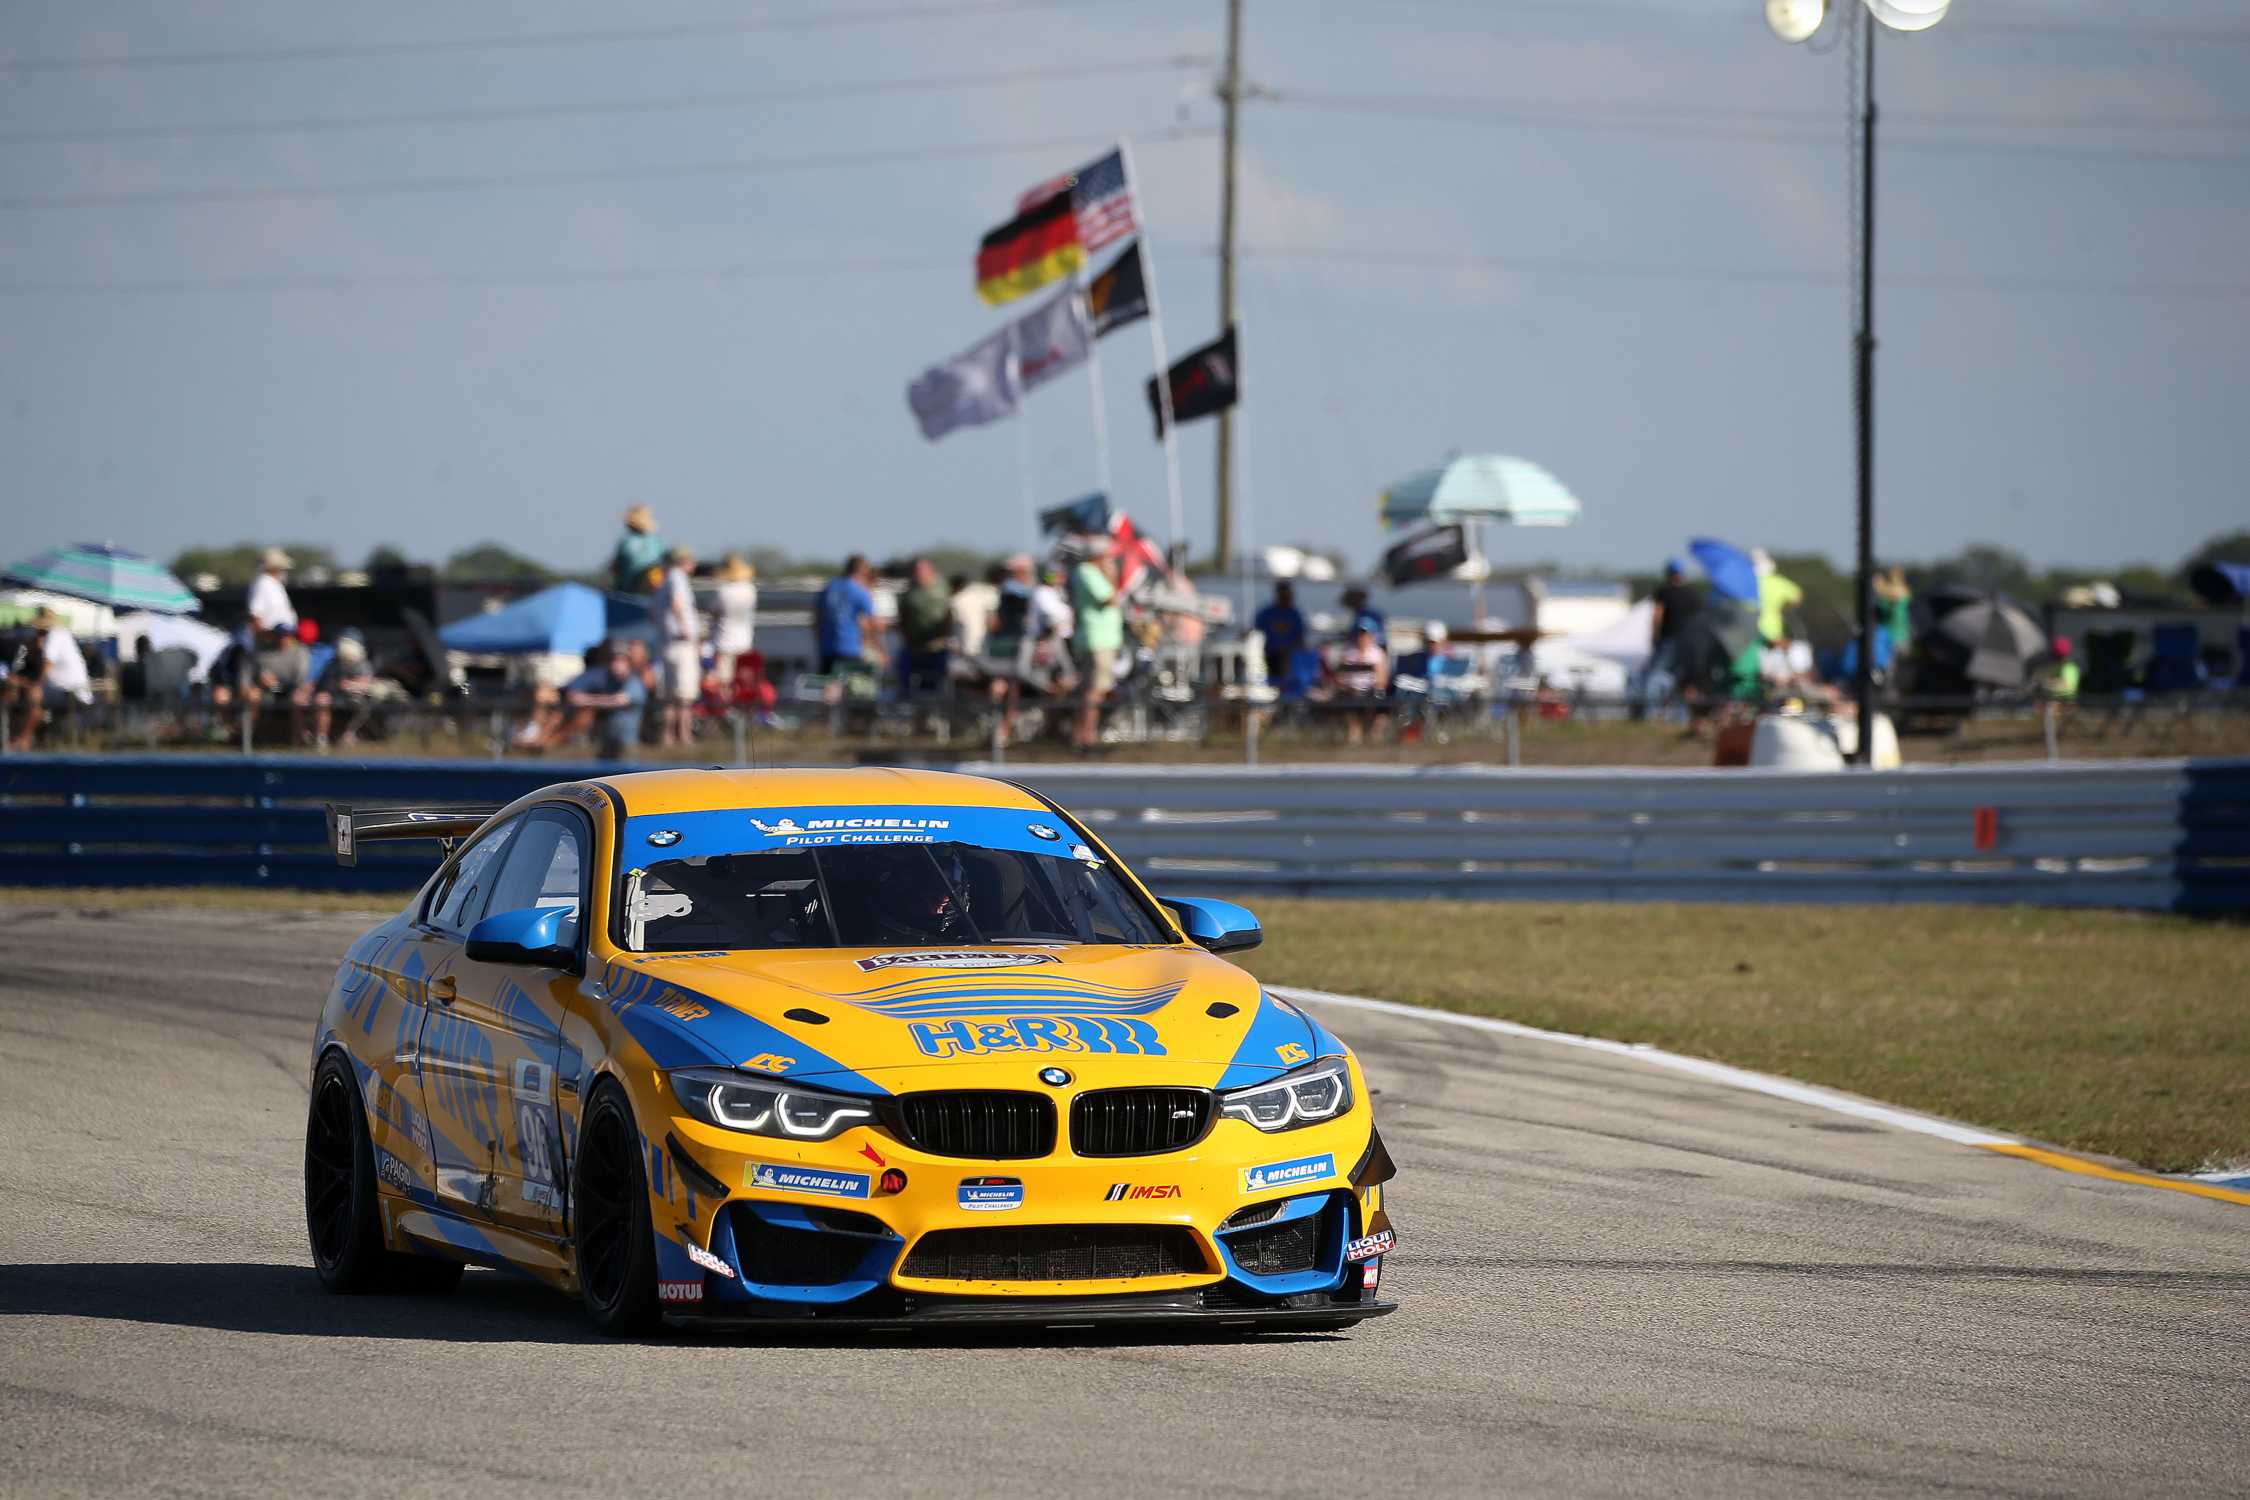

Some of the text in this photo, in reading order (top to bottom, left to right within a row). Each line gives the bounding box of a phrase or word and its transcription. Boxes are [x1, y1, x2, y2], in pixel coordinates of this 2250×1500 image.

[808, 818, 950, 829] MICHELIN
[786, 834, 934, 846] PILOT CHALLENGE
[908, 1017, 1084, 1058] H&R
[1267, 1161, 1328, 1182] MICHELIN
[779, 1173, 860, 1191] MICHELIN
[978, 1190, 1015, 1198] MICHELIN
[1129, 1184, 1182, 1200] IMSA
[1347, 1231, 1392, 1251] LIQUI
[1349, 1240, 1393, 1260] MOLY
